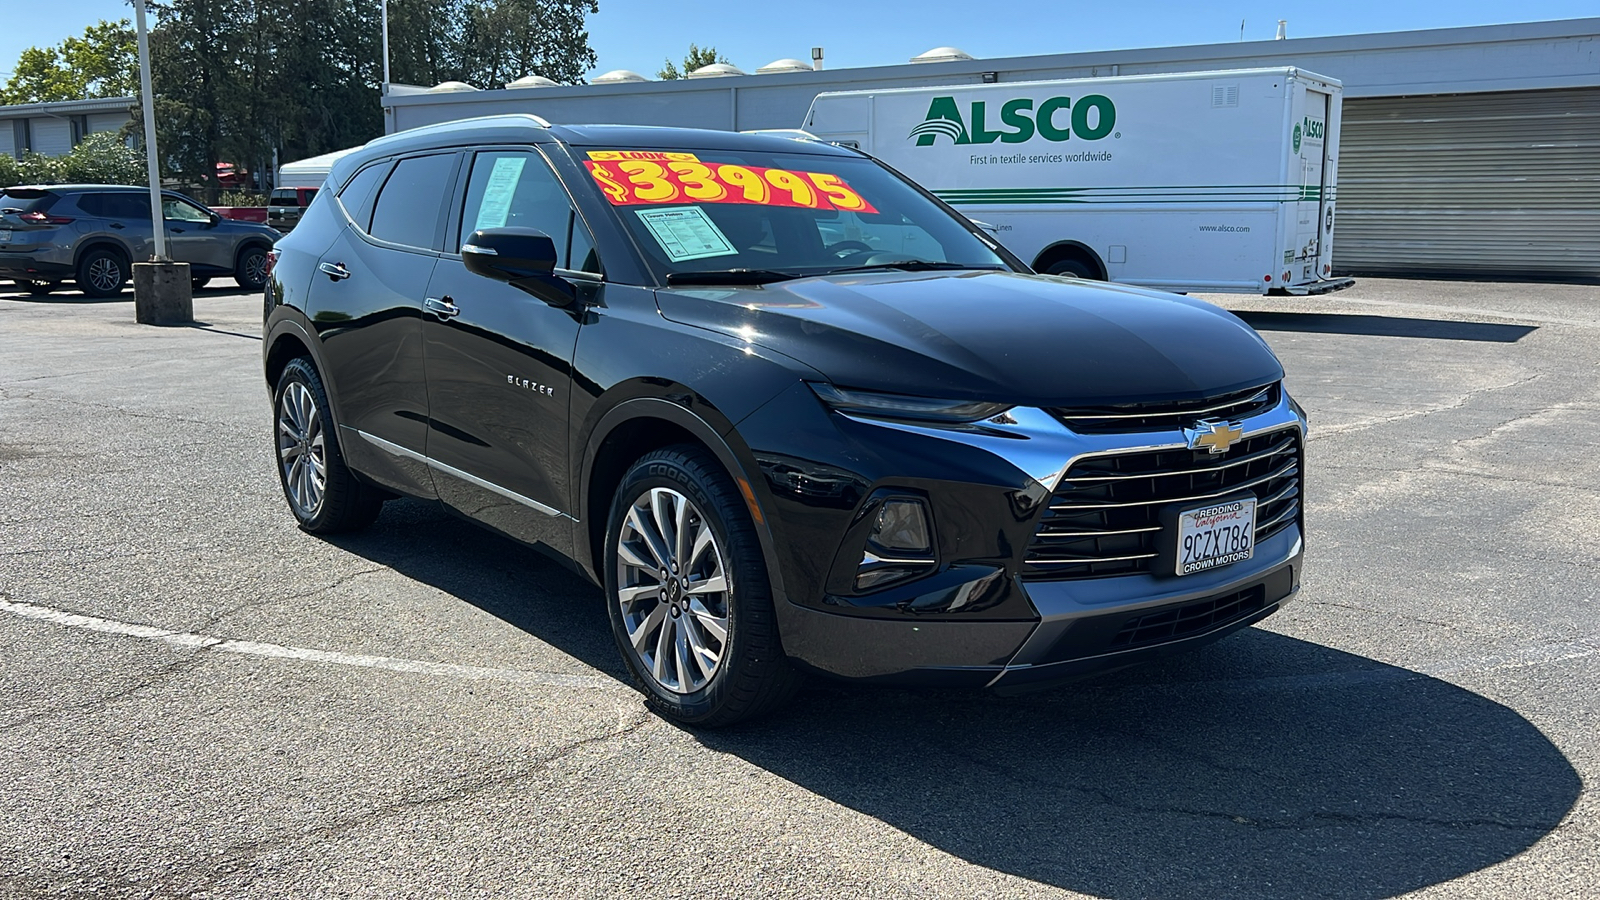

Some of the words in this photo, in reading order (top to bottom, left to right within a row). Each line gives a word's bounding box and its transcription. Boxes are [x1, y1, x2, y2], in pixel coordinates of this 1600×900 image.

[911, 94, 1116, 147] ALSCO
[1303, 117, 1324, 139] ALSCO
[619, 151, 669, 161] LOOK
[970, 154, 988, 165] First
[989, 154, 998, 164] in
[1000, 153, 1026, 164] textile
[1028, 152, 1062, 164] services
[1065, 151, 1112, 163] worldwide
[592, 160, 866, 211] $33995
[996, 223, 1013, 232] Linen
[1199, 224, 1250, 233] www.alsco.com
[507, 375, 554, 398] BLAZER
[648, 464, 708, 506] COOPER
[1195, 512, 1242, 529] California
[1200, 503, 1240, 517] REDDING
[1183, 522, 1250, 564] 9CZX786
[1184, 559, 1214, 573] CROWN
[1215, 551, 1249, 565] MOTORS
